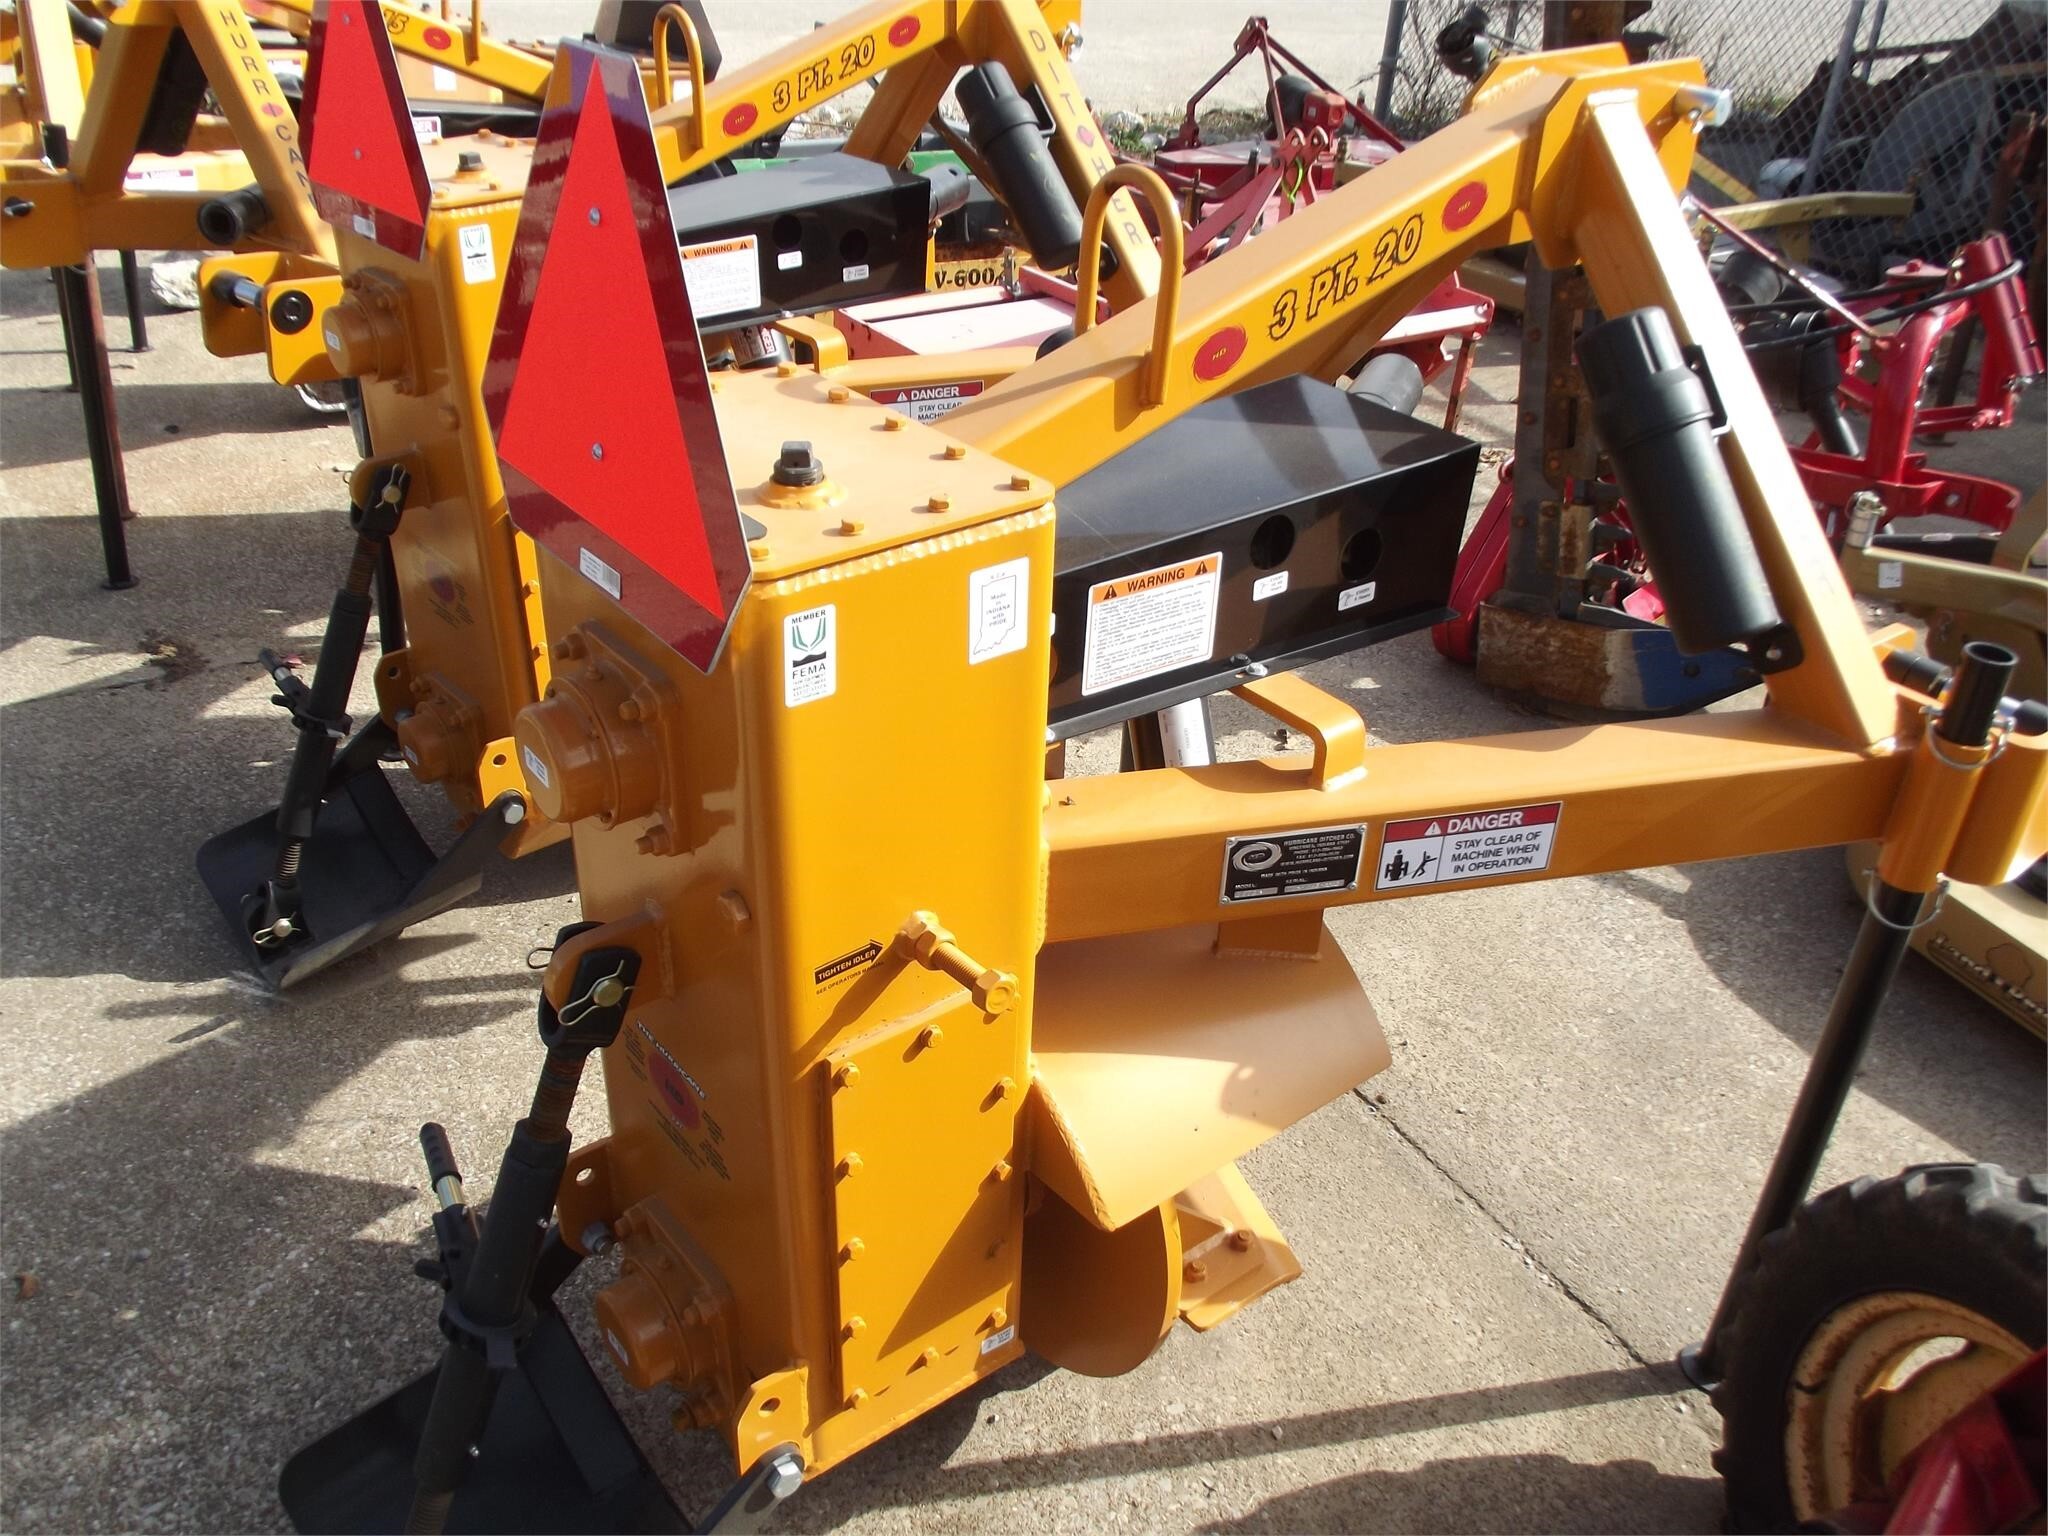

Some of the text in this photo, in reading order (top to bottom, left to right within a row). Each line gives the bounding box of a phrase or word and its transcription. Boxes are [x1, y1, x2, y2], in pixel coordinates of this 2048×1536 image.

[772, 35, 875, 113] 3 PT. 20
[693, 243, 733, 257] WARNING
[1265, 212, 1423, 341] 3 PT. 20
[911, 386, 960, 400] DANGER
[918, 404, 936, 413] STAY
[1127, 567, 1185, 593] WARNING
[791, 609, 826, 625] MEMBER
[792, 663, 826, 680] FEMA
[1447, 811, 1523, 834] DANGER
[1454, 831, 1542, 850] STAY CLEAR OF
[1451, 844, 1540, 862] MACHINE WHEN
[1453, 856, 1533, 873] IN OPERATION
[817, 949, 876, 980] TIGHTEN IDLER
